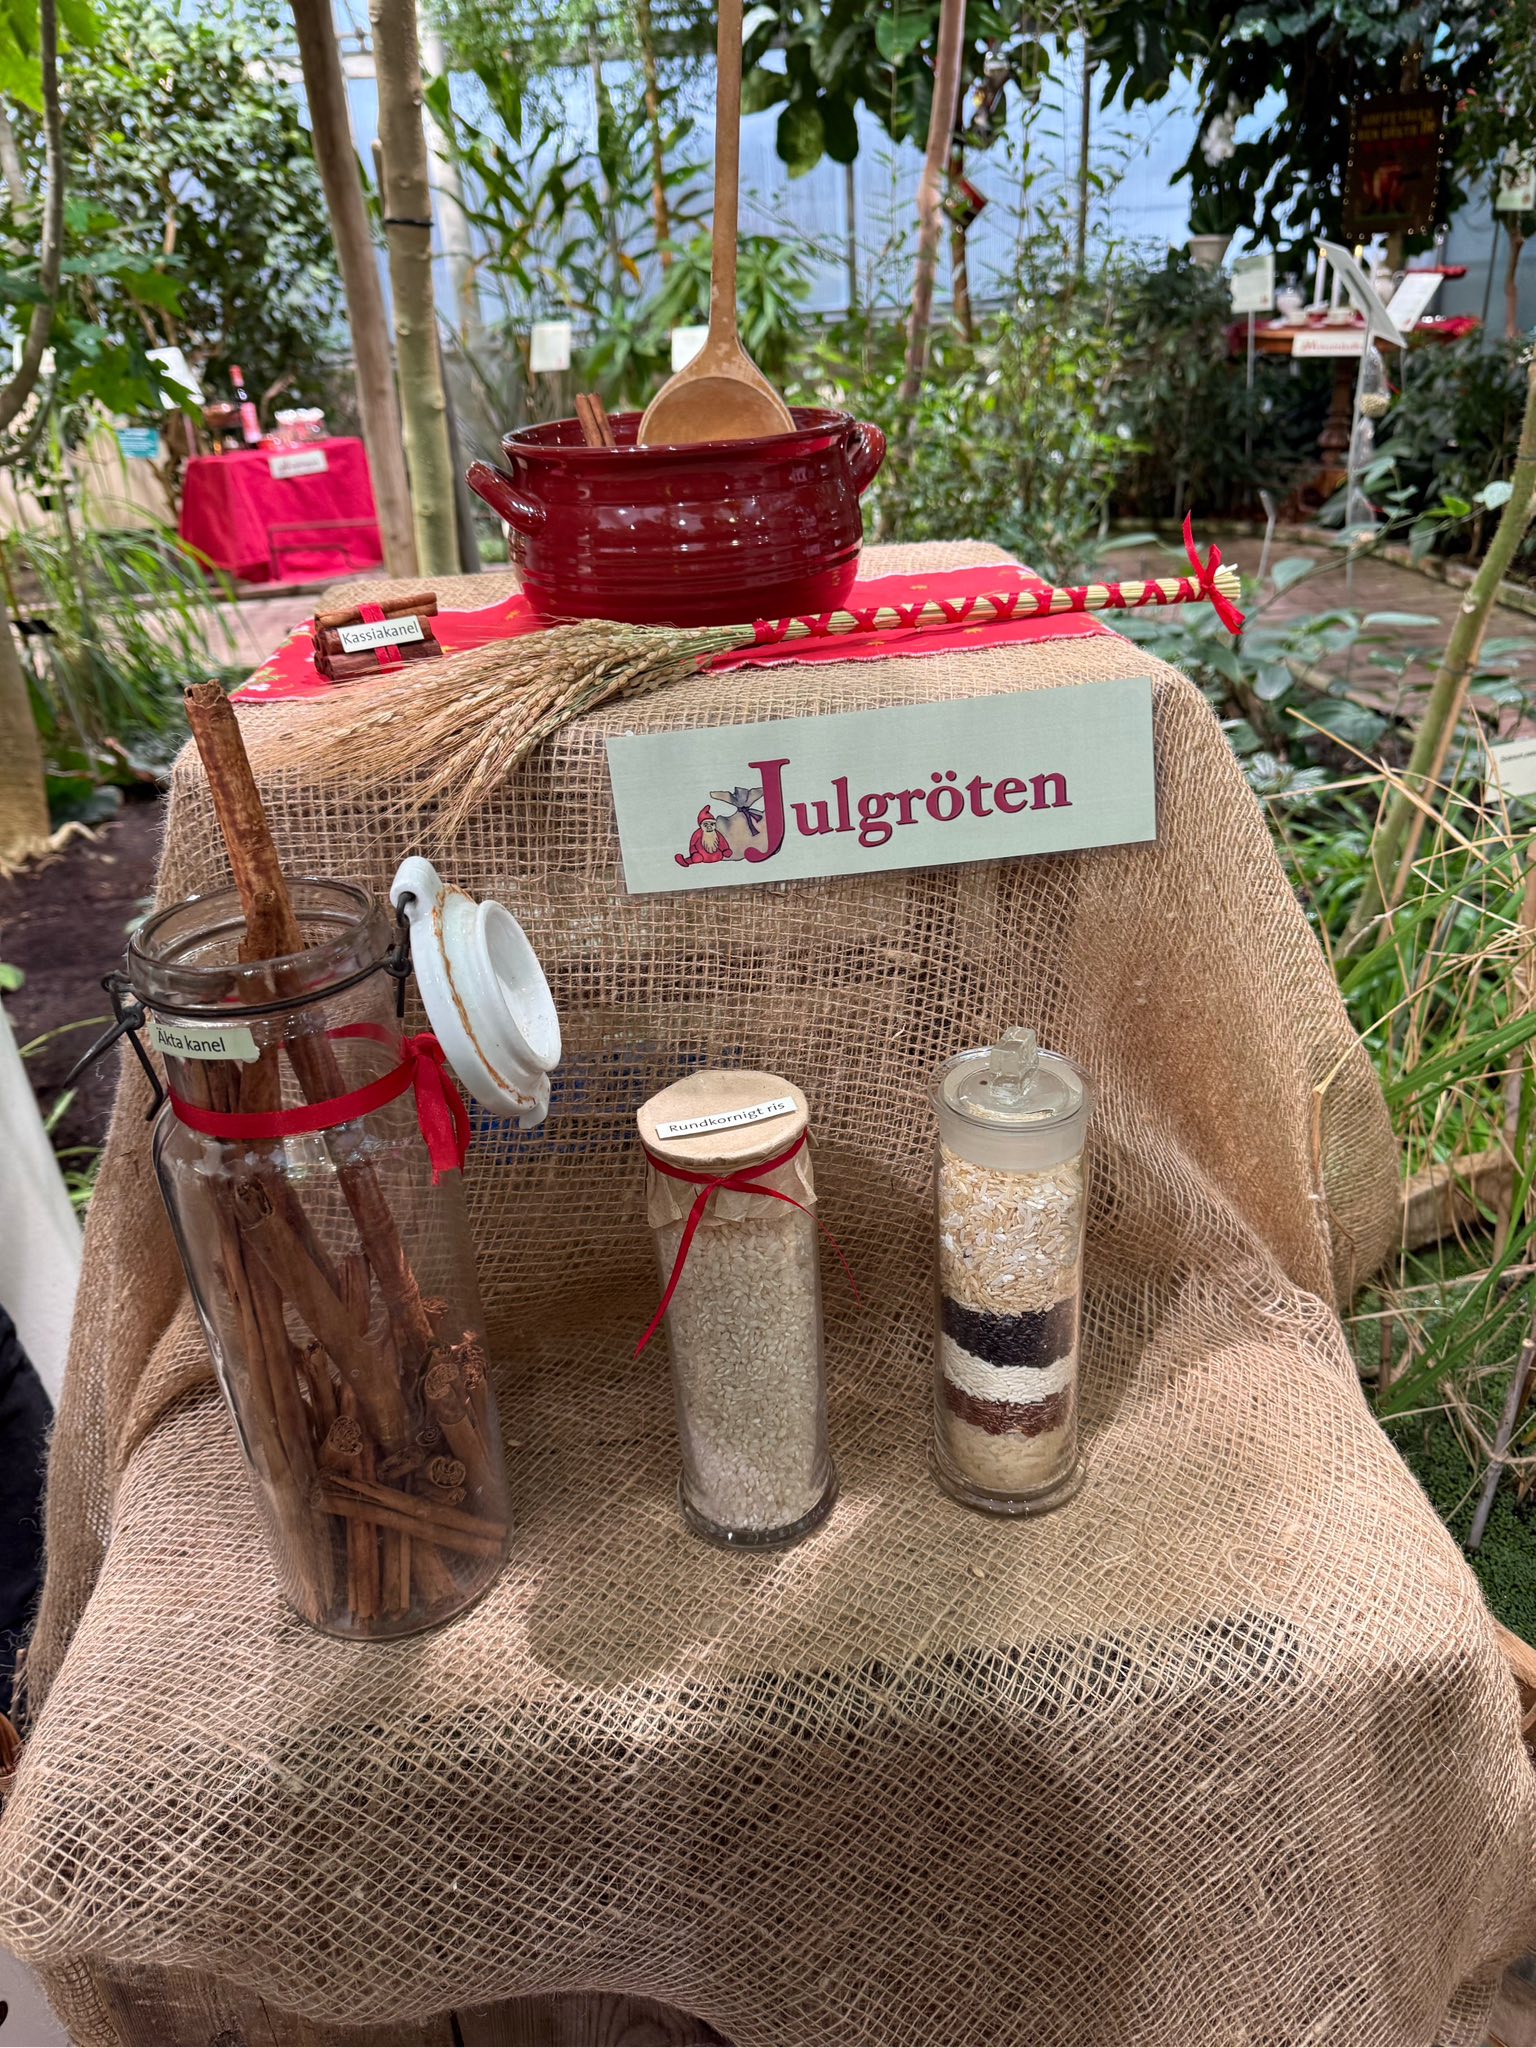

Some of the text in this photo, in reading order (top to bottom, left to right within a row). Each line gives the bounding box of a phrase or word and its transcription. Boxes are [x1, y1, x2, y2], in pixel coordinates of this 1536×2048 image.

[341, 620, 419, 645] Kassiakanel
[743, 758, 1073, 863] Julgröten
[155, 1026, 226, 1053] Äkta kanel
[669, 1101, 785, 1132] Rundkornigt ris
